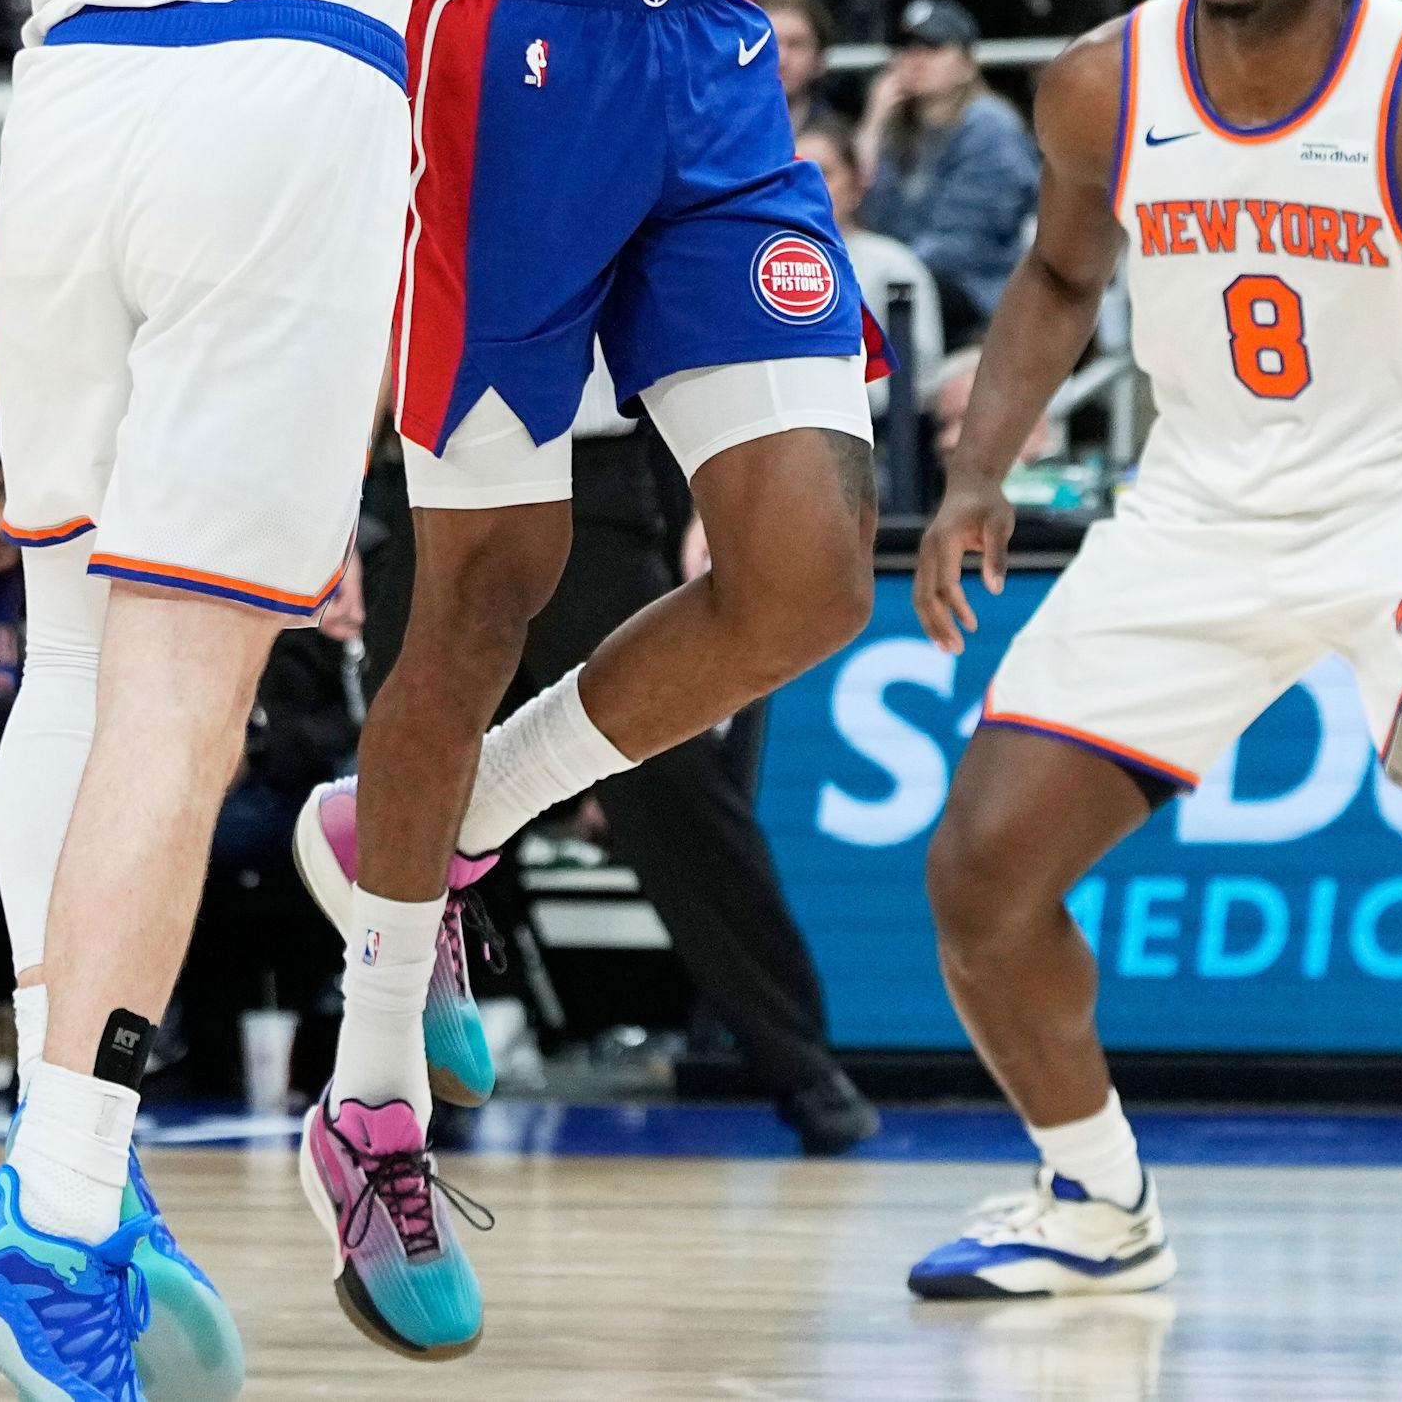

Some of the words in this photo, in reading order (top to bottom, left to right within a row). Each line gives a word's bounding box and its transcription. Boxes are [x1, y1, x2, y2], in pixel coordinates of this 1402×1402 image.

[1300, 149, 1327, 162] abu
[1329, 149, 1369, 164] dhabi
[1135, 200, 1240, 257] NEW
[1245, 200, 1390, 267] YORK
[770, 261, 822, 277] DETROIT
[771, 276, 825, 292] PISTONS
[1222, 273, 1313, 400] 8
[816, 636, 984, 848] S
[113, 1026, 141, 1049] KT
